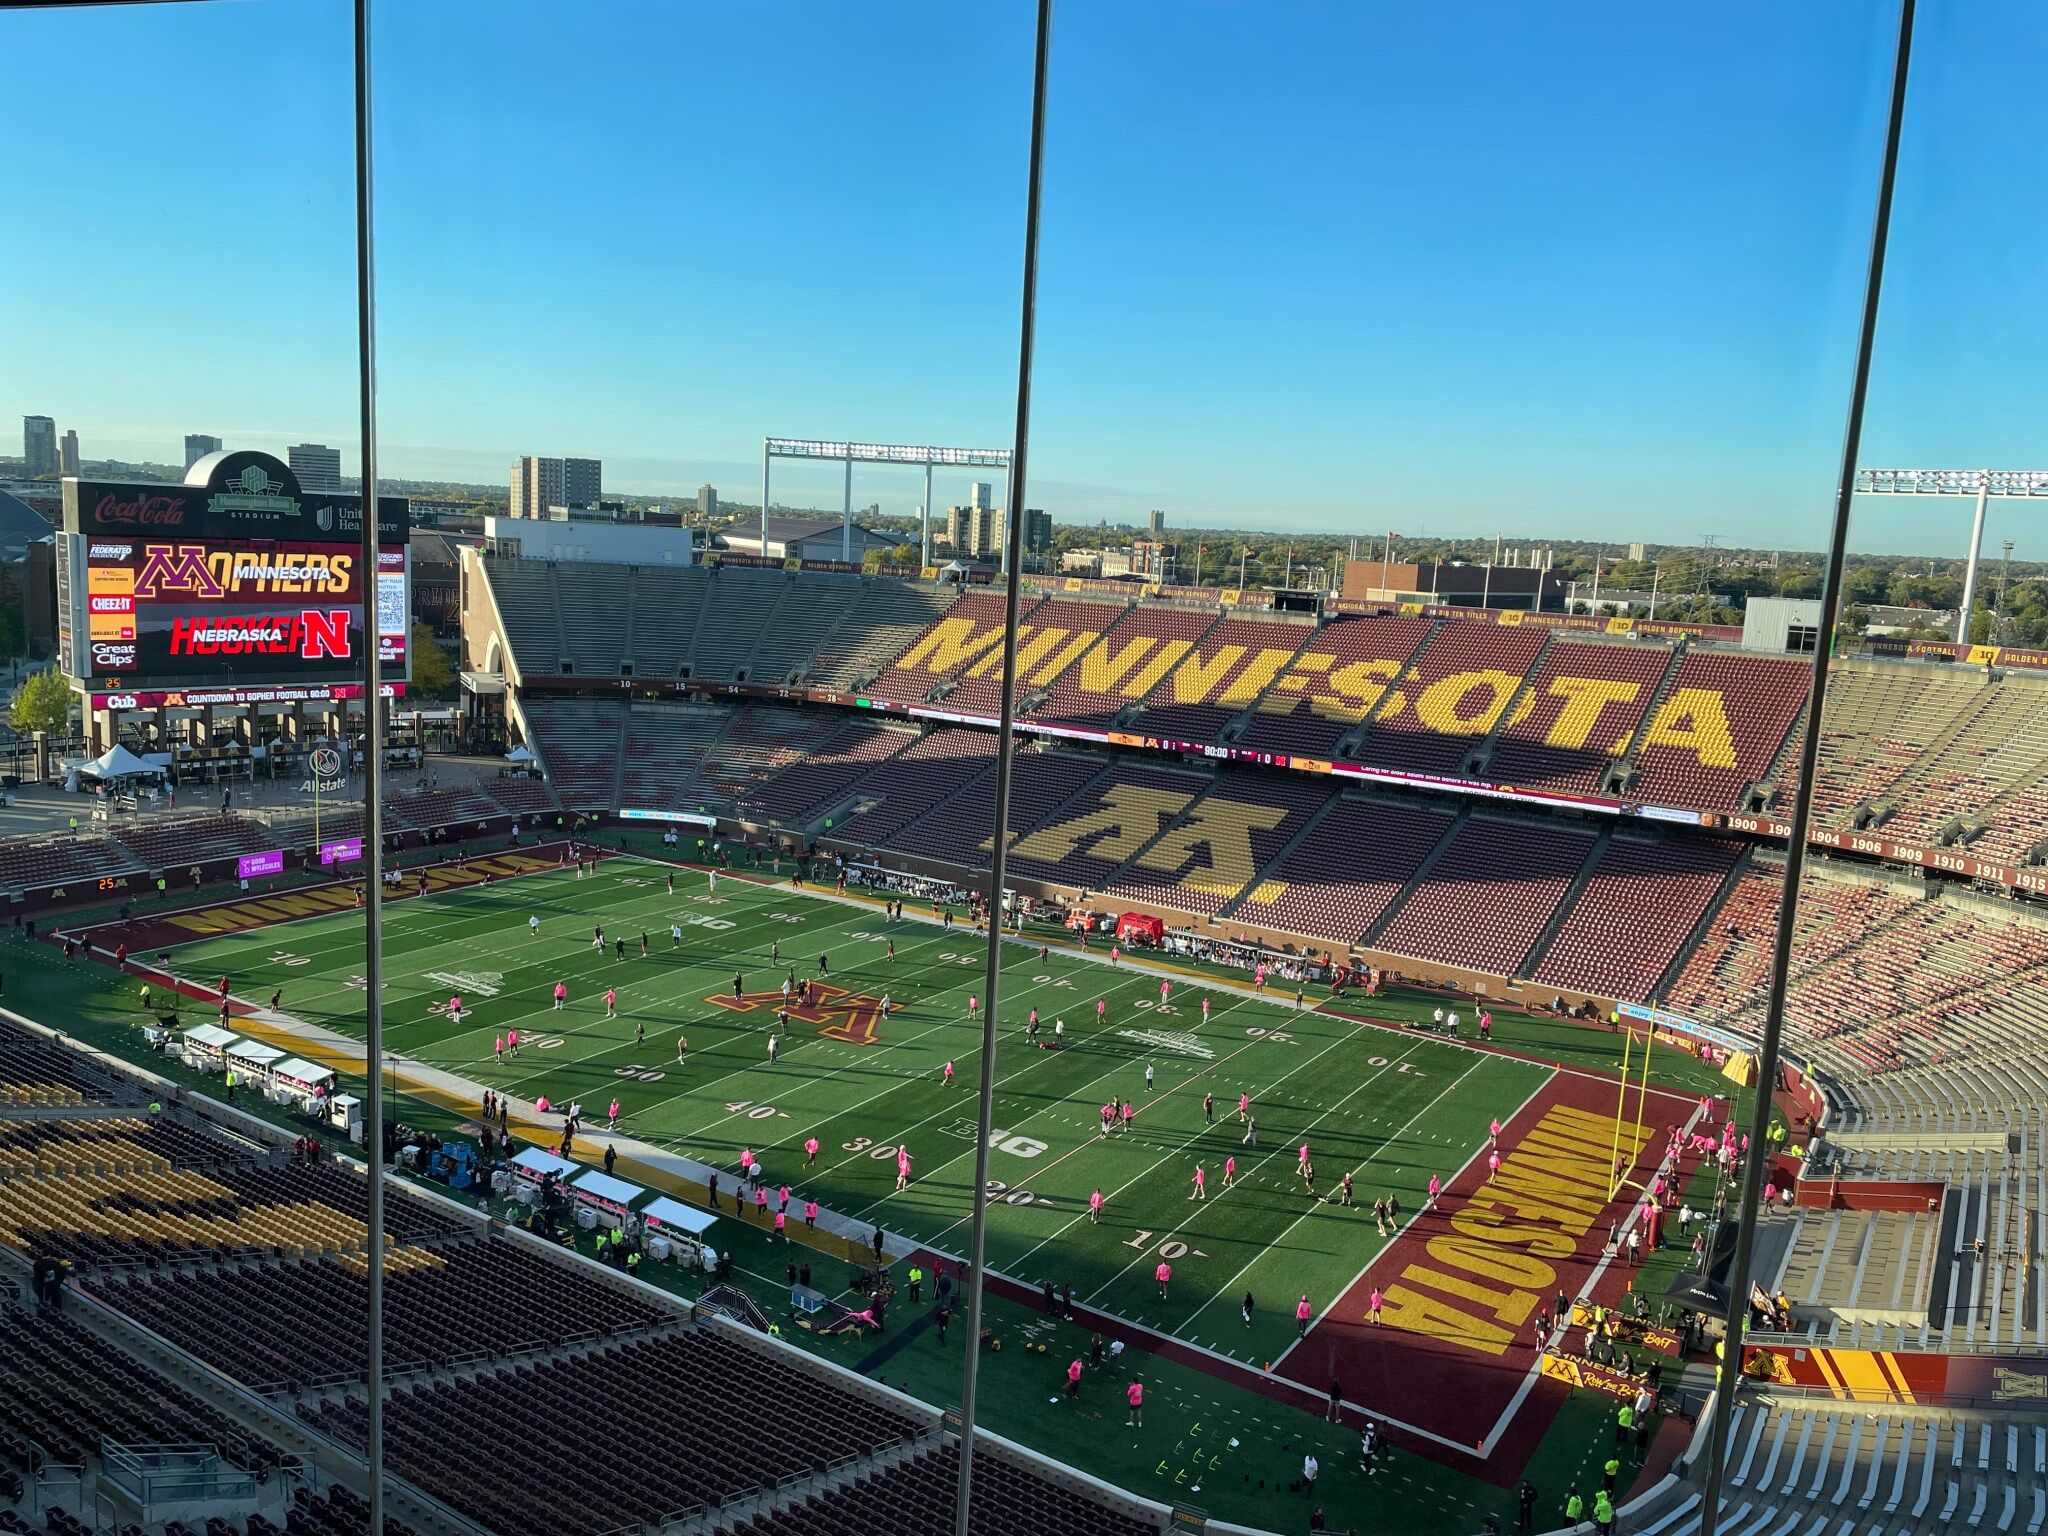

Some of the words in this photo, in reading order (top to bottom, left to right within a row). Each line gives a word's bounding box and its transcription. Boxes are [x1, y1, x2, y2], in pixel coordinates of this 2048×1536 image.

[220, 496, 267, 509] Huntington
[268, 499, 290, 509] Bank
[231, 512, 280, 520] STADIUM
[339, 508, 363, 519] Unit
[91, 547, 132, 555] FEDERATED
[722, 556, 751, 564] MINNESOTA
[753, 558, 777, 566] FOOTBALL
[808, 562, 826, 570] GOLDEN
[197, 552, 353, 592] OPHERS
[233, 566, 332, 581] MINNESOTA
[1165, 588, 1184, 597] GOLDEN
[1466, 612, 1488, 620] TITLES
[1524, 616, 1563, 625] MINNESOTA
[1565, 618, 1599, 628] FOOTBALL
[193, 628, 282, 643] NEBRASKA
[302, 611, 350, 659] N
[1637, 624, 1666, 633] GOLDEN
[1668, 626, 1703, 636] GOPHERS
[92, 643, 136, 654] Great
[1867, 641, 1912, 653] MINNESOTA
[1916, 644, 1957, 656] FOOTBALL
[96, 654, 133, 667] Clips
[2005, 653, 2039, 664] GOLDEN
[107, 679, 120, 688] 25
[620, 680, 631, 688] 10
[675, 682, 686, 691] 15
[728, 685, 739, 694] 54
[187, 693, 234, 704] COUNTDOWN
[235, 693, 245, 702] TO
[247, 691, 274, 702] GOPHER
[276, 690, 309, 700] FOOTBALL
[310, 689, 330, 699] 90:00
[379, 685, 395, 698] ub
[779, 689, 789, 698] 72
[896, 618, 1738, 770] MINNESOTA
[108, 695, 136, 709] Cub
[1162, 739, 1169, 749] 0
[1204, 745, 1228, 758] 90:00
[1264, 754, 1271, 764] 0
[1728, 817, 1758, 831] 1900
[1769, 823, 1791, 837] 190
[1811, 829, 1840, 846] 1904
[1852, 837, 1882, 854] 1906
[1892, 846, 1923, 862] 1909
[251, 857, 266, 866] GOOD
[251, 861, 281, 873] MOLECULES
[1933, 854, 1965, 871] 1910
[1975, 863, 2004, 882] 1911
[99, 878, 114, 890] 25
[2015, 873, 2046, 891] 1915
[267, 951, 312, 967] 10
[1031, 975, 1073, 989] 40
[1133, 999, 1178, 1016] 30
[1630, 1008, 1649, 1019] enjoy
[520, 1033, 565, 1049] 40
[1245, 1027, 1295, 1043] 20
[1367, 1056, 1418, 1074] 10
[613, 1064, 666, 1083] 50
[725, 1100, 777, 1119] 40
[841, 1137, 898, 1160] 30
[973, 1180, 1035, 1206] 20
[1363, 1104, 1657, 1356] MINNESOTA
[1122, 1229, 1188, 1259] 10
